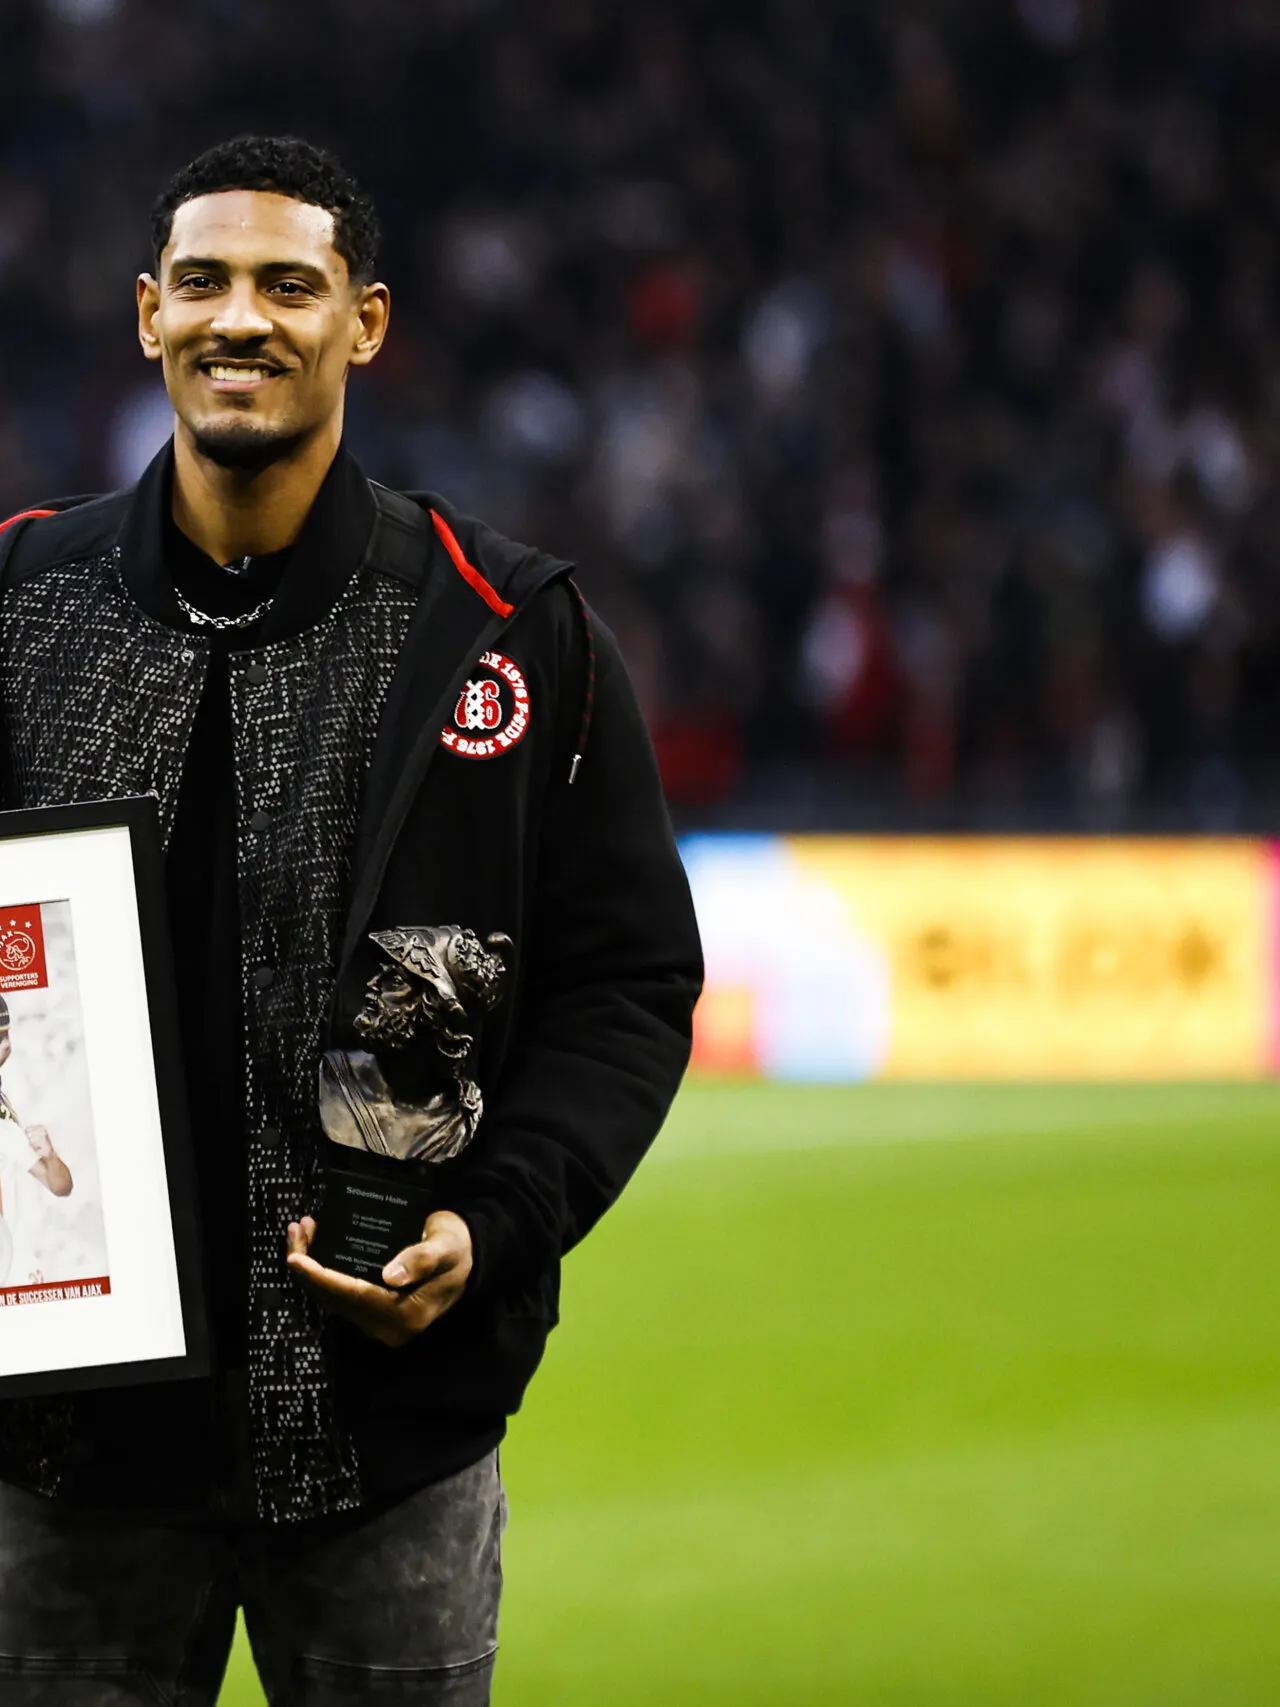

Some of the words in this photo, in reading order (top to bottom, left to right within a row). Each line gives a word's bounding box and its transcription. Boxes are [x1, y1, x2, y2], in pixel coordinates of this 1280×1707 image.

[501, 663, 528, 698] 1976
[495, 701, 529, 747] F-SIDE
[456, 739, 496, 755] 1976
[0, 972, 39, 983] SUPPORTERS
[0, 979, 39, 989] VERENIGING
[6, 1293, 18, 1307] DE
[19, 1287, 63, 1305] SUCCESSEN
[64, 1285, 81, 1300] VAN
[82, 1284, 102, 1298] AJAX
